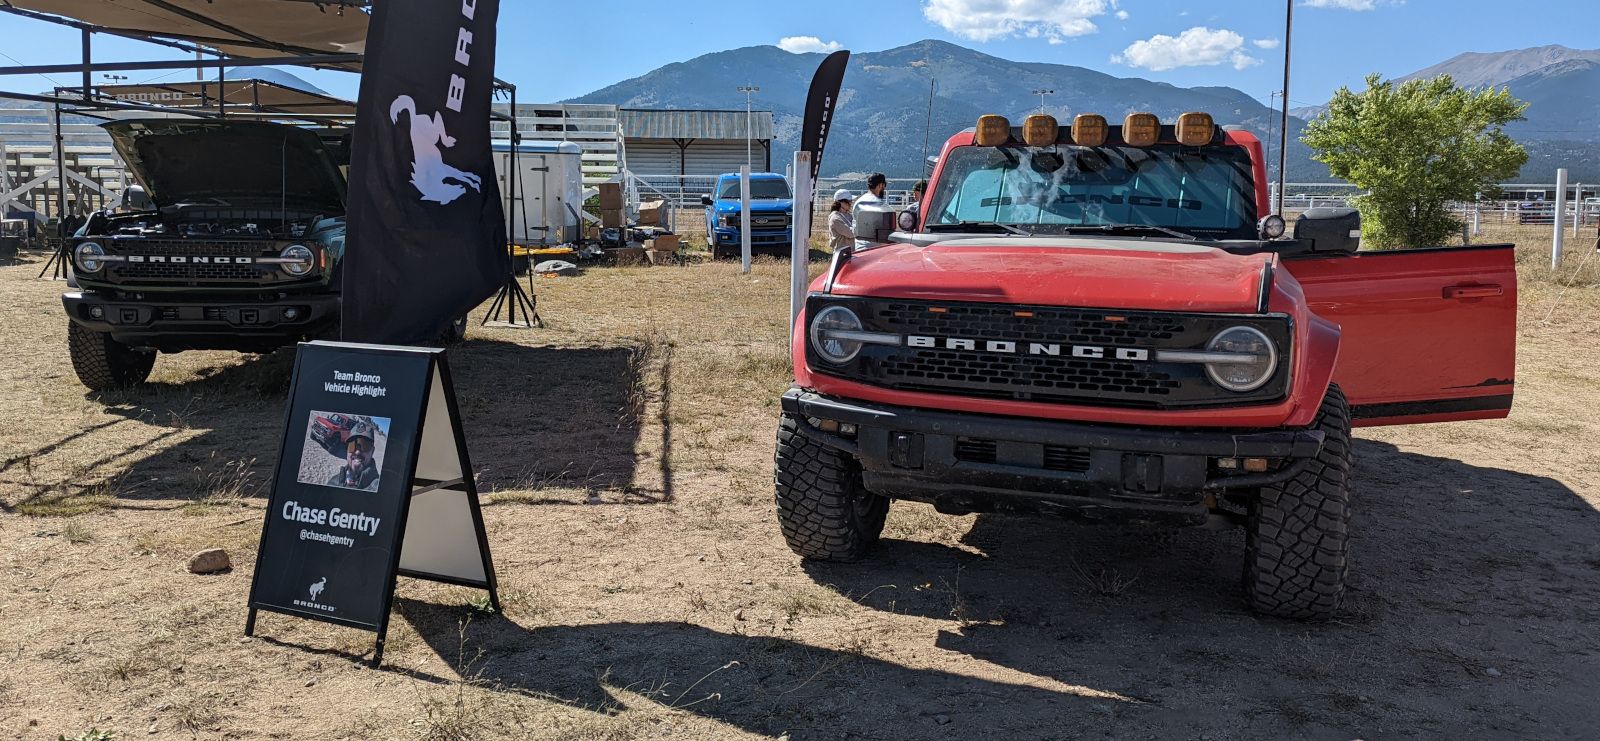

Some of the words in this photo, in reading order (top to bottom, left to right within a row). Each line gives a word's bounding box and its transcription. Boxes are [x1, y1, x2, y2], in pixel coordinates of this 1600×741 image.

[116, 92, 183, 101] BRONCO
[128, 255, 252, 264] BRONCO
[907, 335, 1149, 361] BRONCO
[333, 370, 354, 381] Team
[354, 372, 381, 383] Bronco
[324, 381, 351, 393] Vehicle
[351, 384, 387, 397] Highlight
[282, 500, 327, 525] Chase
[328, 507, 380, 536] Gentry
[299, 528, 354, 548] @chasehgentry
[293, 599, 335, 612] BRONCO
